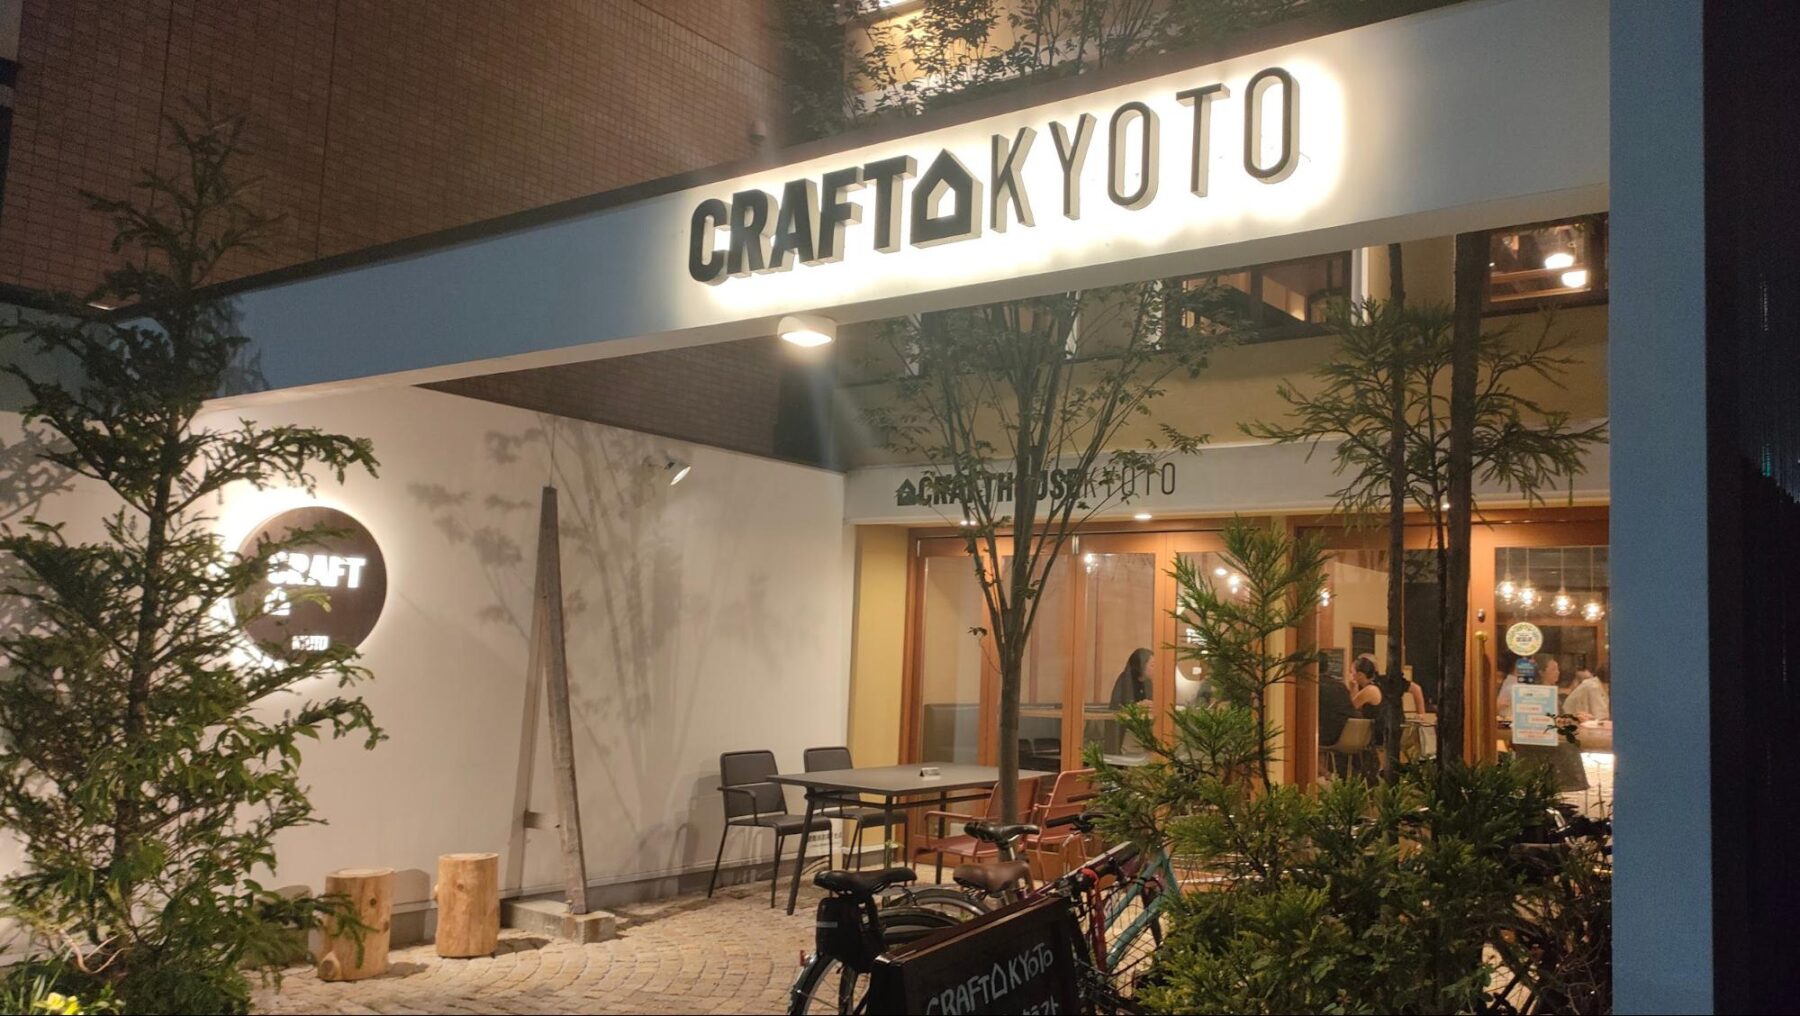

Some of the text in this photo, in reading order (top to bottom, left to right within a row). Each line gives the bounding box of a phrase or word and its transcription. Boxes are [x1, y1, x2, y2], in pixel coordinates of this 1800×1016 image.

[688, 67, 1300, 286] CRAFT KYOTO
[919, 468, 1080, 505] CRAFTHUSE
[266, 551, 367, 588] CRAFT
[926, 974, 991, 1014] CRAFT
